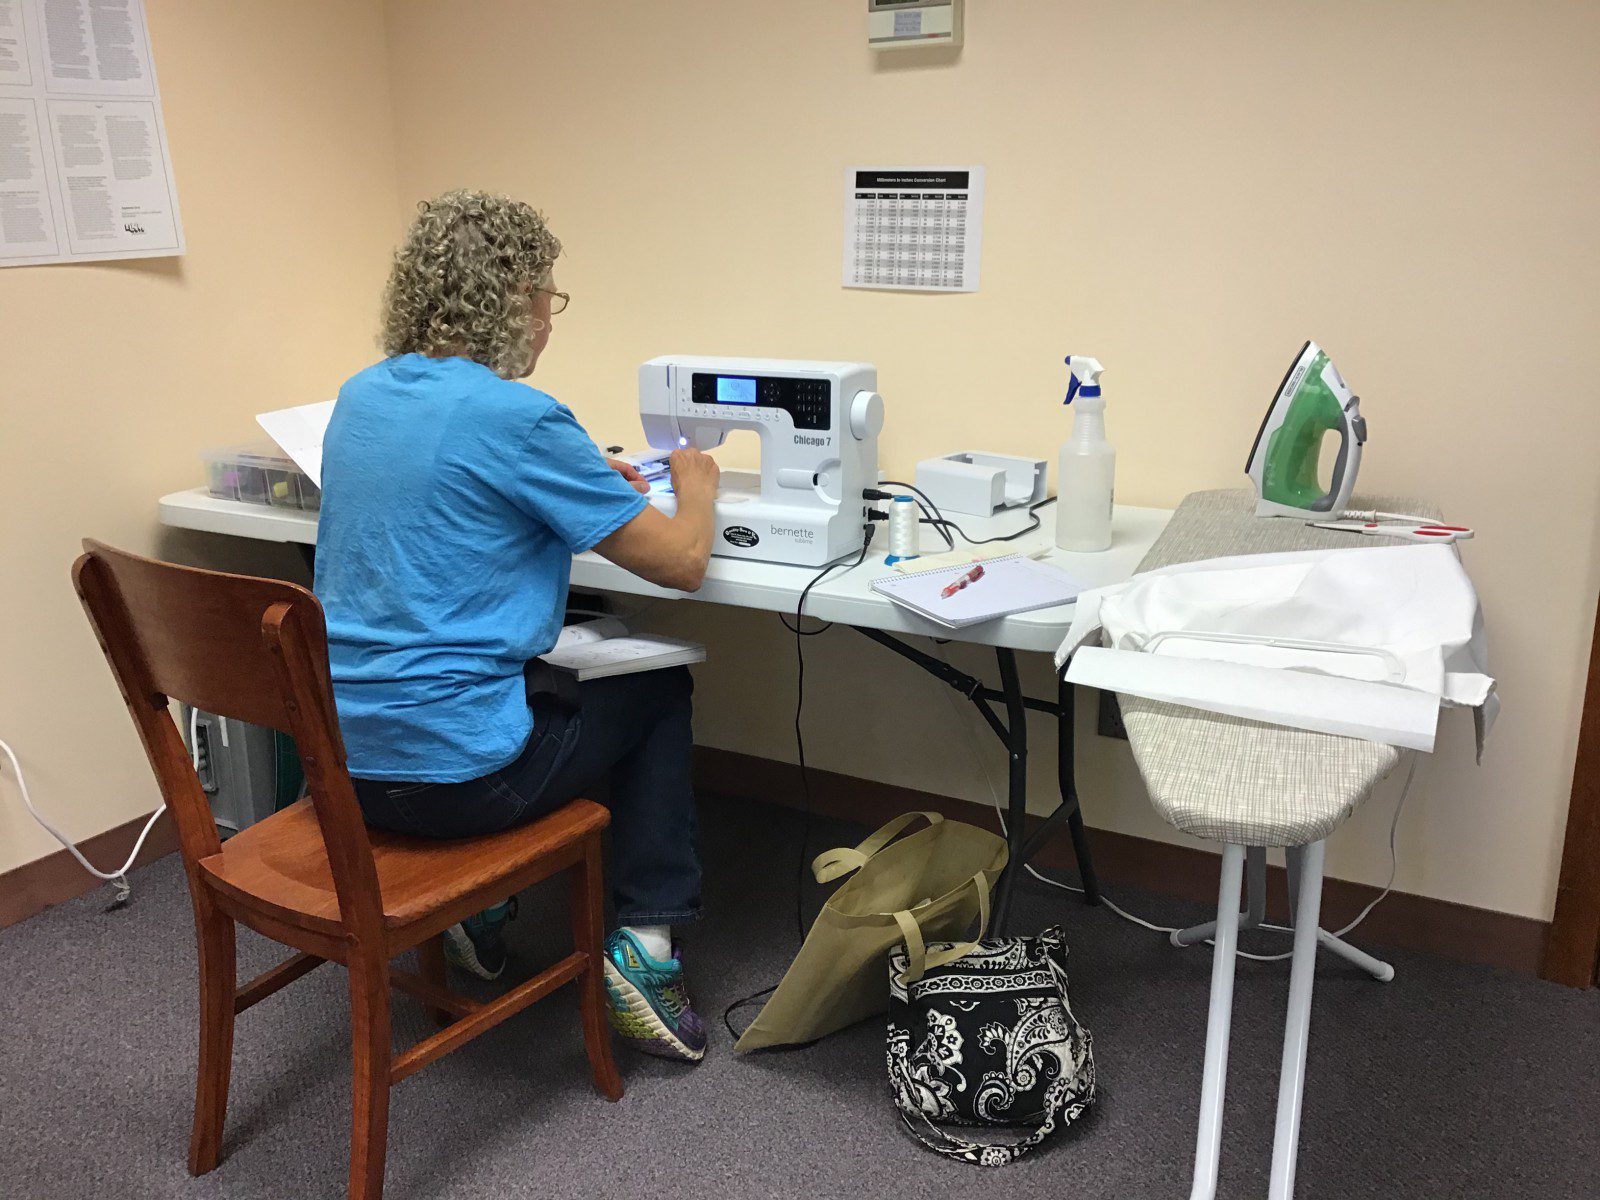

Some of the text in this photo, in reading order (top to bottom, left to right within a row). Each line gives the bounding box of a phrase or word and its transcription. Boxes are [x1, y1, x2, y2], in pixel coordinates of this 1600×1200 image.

[793, 434, 832, 447] Chicago 7
[770, 524, 814, 539] bernette
